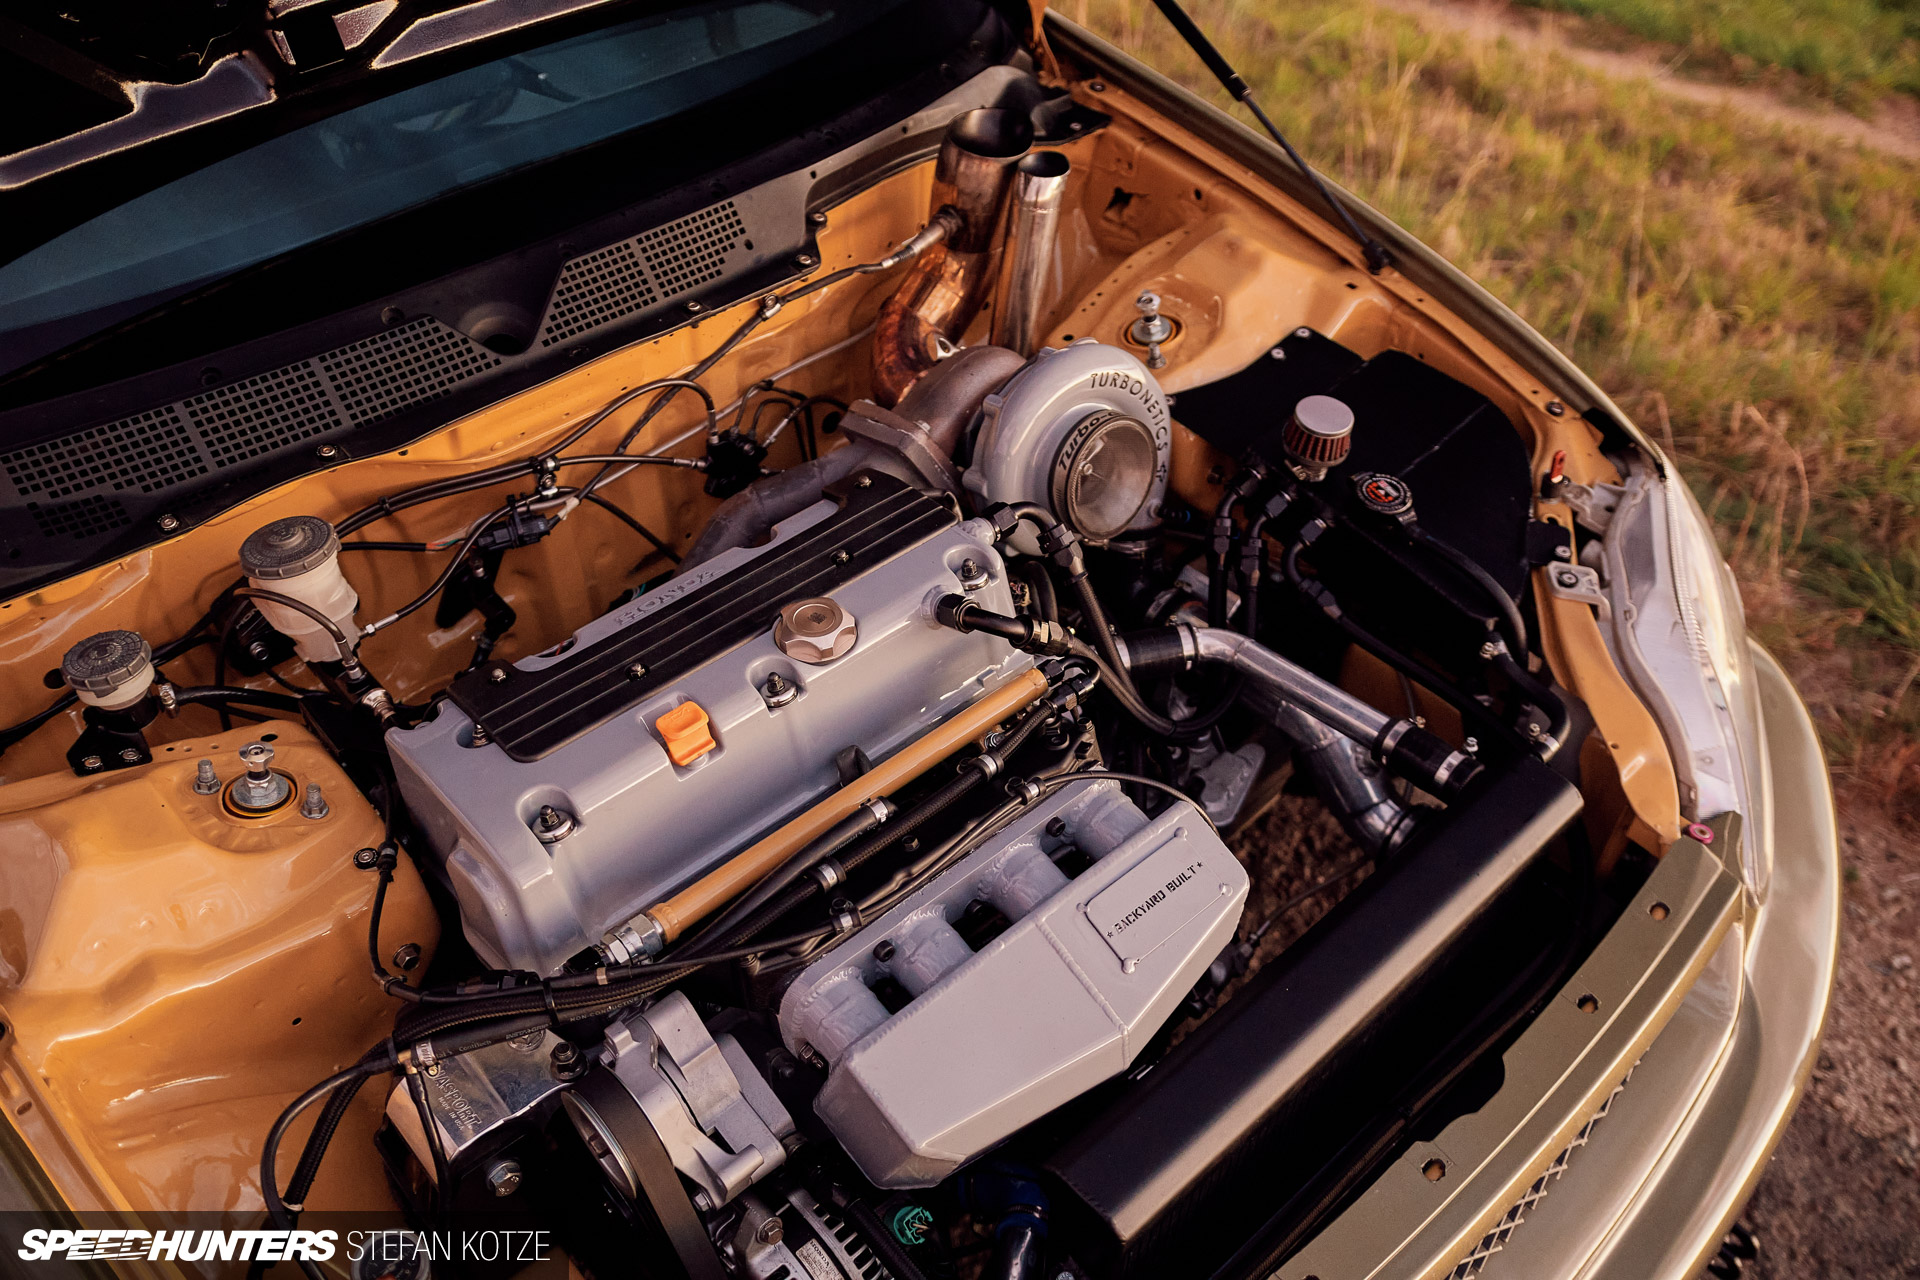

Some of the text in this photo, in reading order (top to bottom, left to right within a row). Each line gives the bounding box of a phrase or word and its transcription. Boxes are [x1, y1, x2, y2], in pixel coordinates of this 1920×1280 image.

[1090, 371, 1169, 452] TURBONETICS
[1114, 864, 1197, 934] BACKYARD BUILT
[810, 1240, 830, 1268] HONDA
